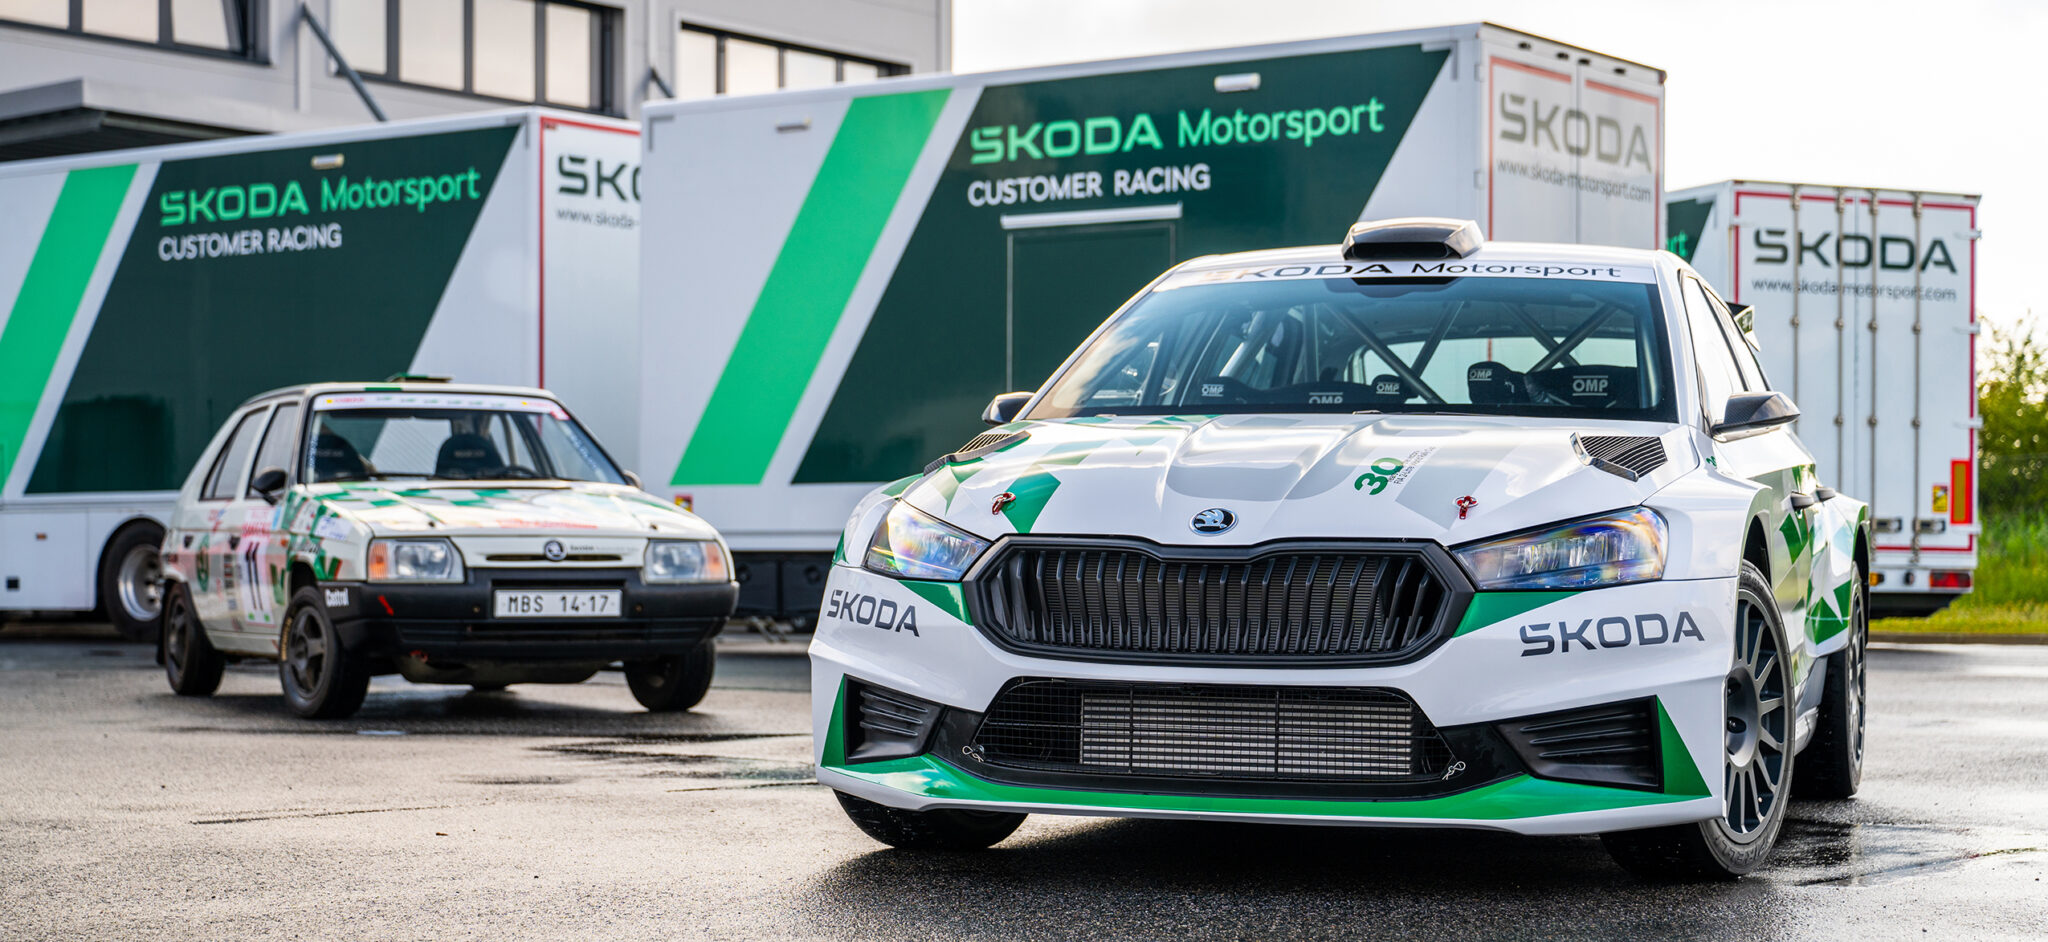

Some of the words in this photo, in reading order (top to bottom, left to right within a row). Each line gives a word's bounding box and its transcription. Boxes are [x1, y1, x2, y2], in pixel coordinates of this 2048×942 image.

[1178, 97, 1385, 147] Motorsport
[321, 167, 480, 213] Motorsport
[967, 170, 1102, 207] CUSTOMER
[1114, 163, 1211, 196] RACING
[158, 228, 264, 261] CUSTOMER
[267, 223, 342, 252] RACING
[1411, 262, 1622, 278] Motorsport
[1751, 278, 1957, 302] www.kodamotorspor.com
[1469, 368, 1493, 380] OMP
[1201, 385, 1224, 396] OMP
[1376, 383, 1400, 394] OMP
[1572, 378, 1609, 394] OMP
[1354, 457, 1404, 495] 30
[508, 595, 543, 613] MBS
